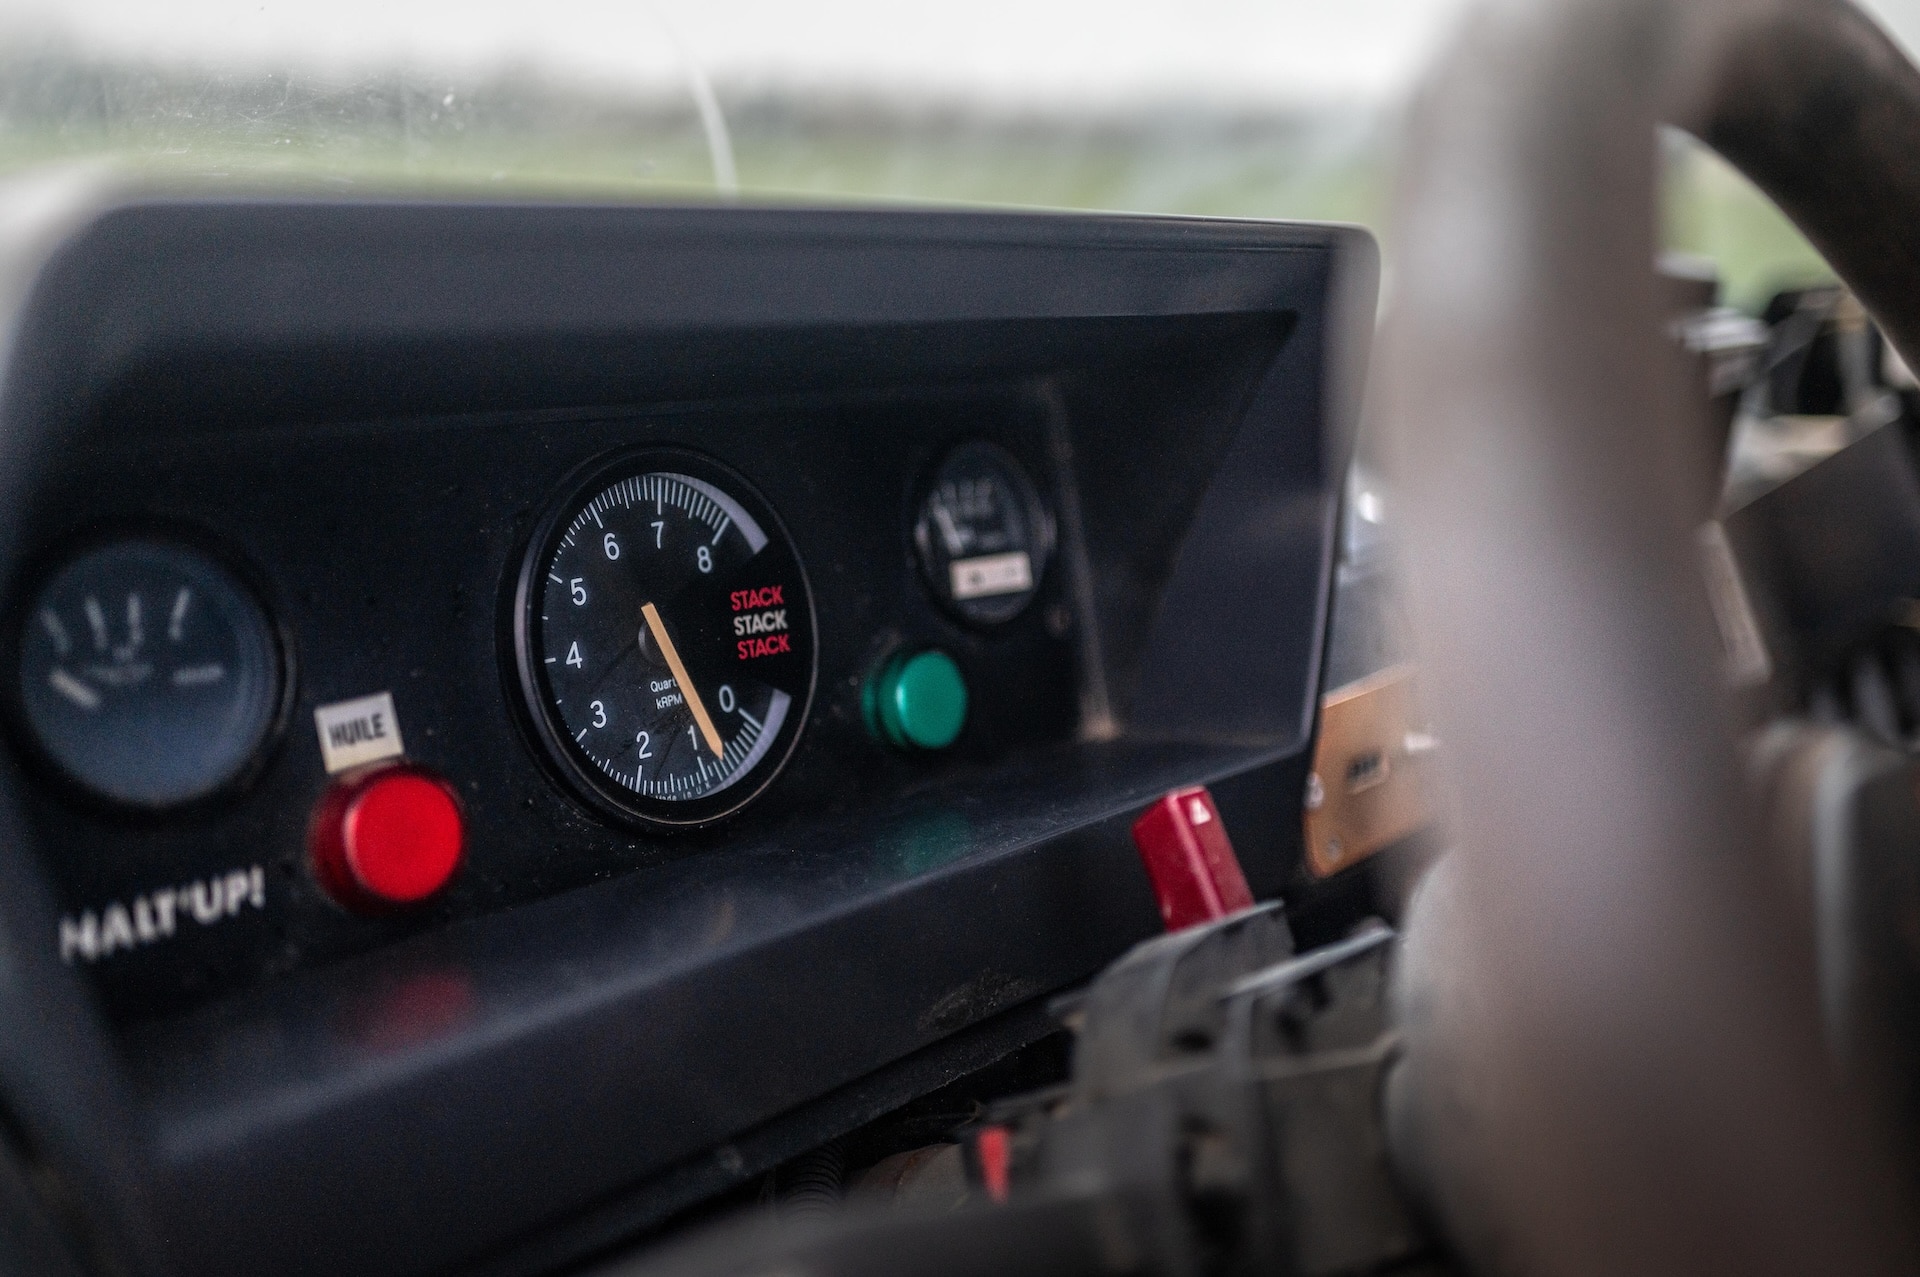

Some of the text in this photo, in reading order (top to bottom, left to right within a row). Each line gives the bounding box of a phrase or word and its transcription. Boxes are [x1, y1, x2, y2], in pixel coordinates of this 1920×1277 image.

[603, 533, 620, 561] 6
[651, 521, 664, 549] 7
[697, 546, 713, 574] 8
[570, 577, 587, 606] 5
[730, 585, 784, 611] STACK
[733, 609, 788, 636] STACK
[565, 641, 583, 669] 4
[737, 634, 791, 660] STACK
[650, 677, 678, 693] Quart
[718, 684, 735, 713] 0
[590, 700, 607, 728] 3
[655, 692, 683, 710] kRPM
[328, 713, 386, 748] HUILE
[687, 724, 699, 750] 1
[636, 731, 652, 759] 2
